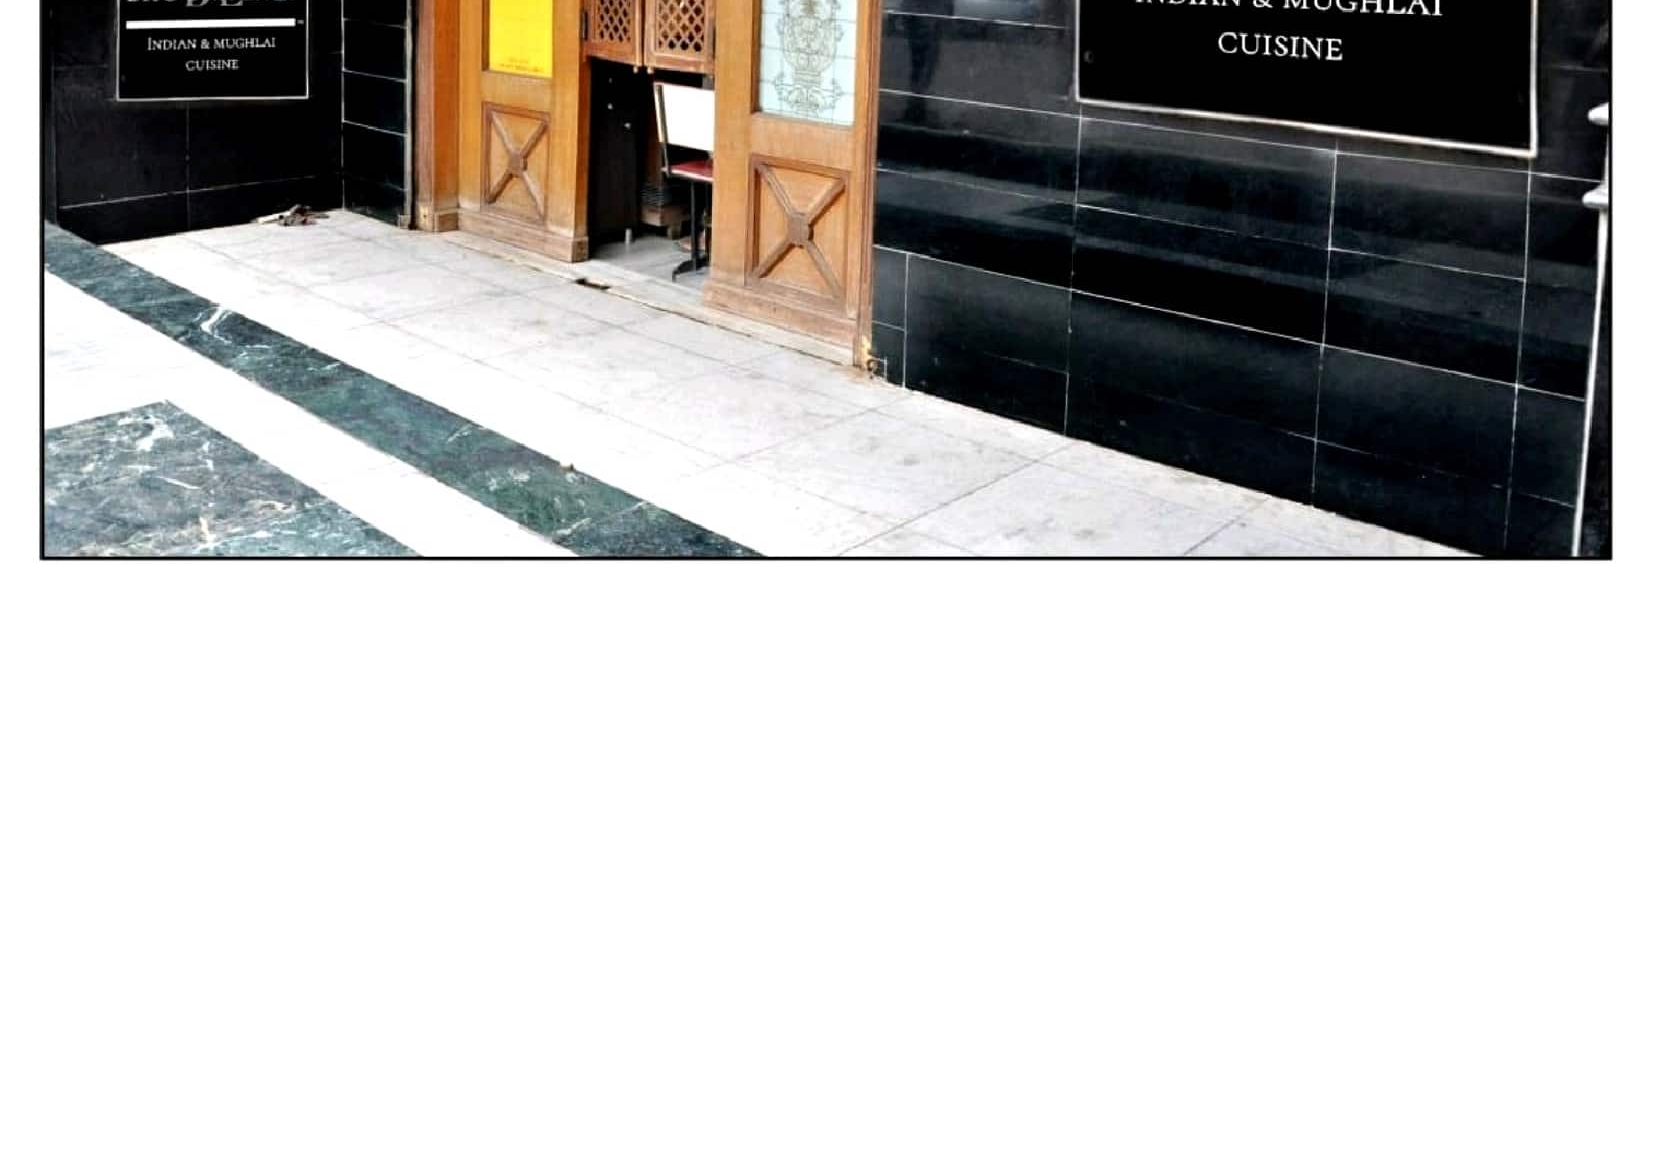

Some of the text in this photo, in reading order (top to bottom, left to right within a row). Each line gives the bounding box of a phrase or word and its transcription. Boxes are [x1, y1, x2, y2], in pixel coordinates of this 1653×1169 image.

[147, 37, 276, 51] INDIAN & MUGHLAI
[1217, 32, 1343, 61] CUISINE
[185, 59, 239, 72] CUISINE
